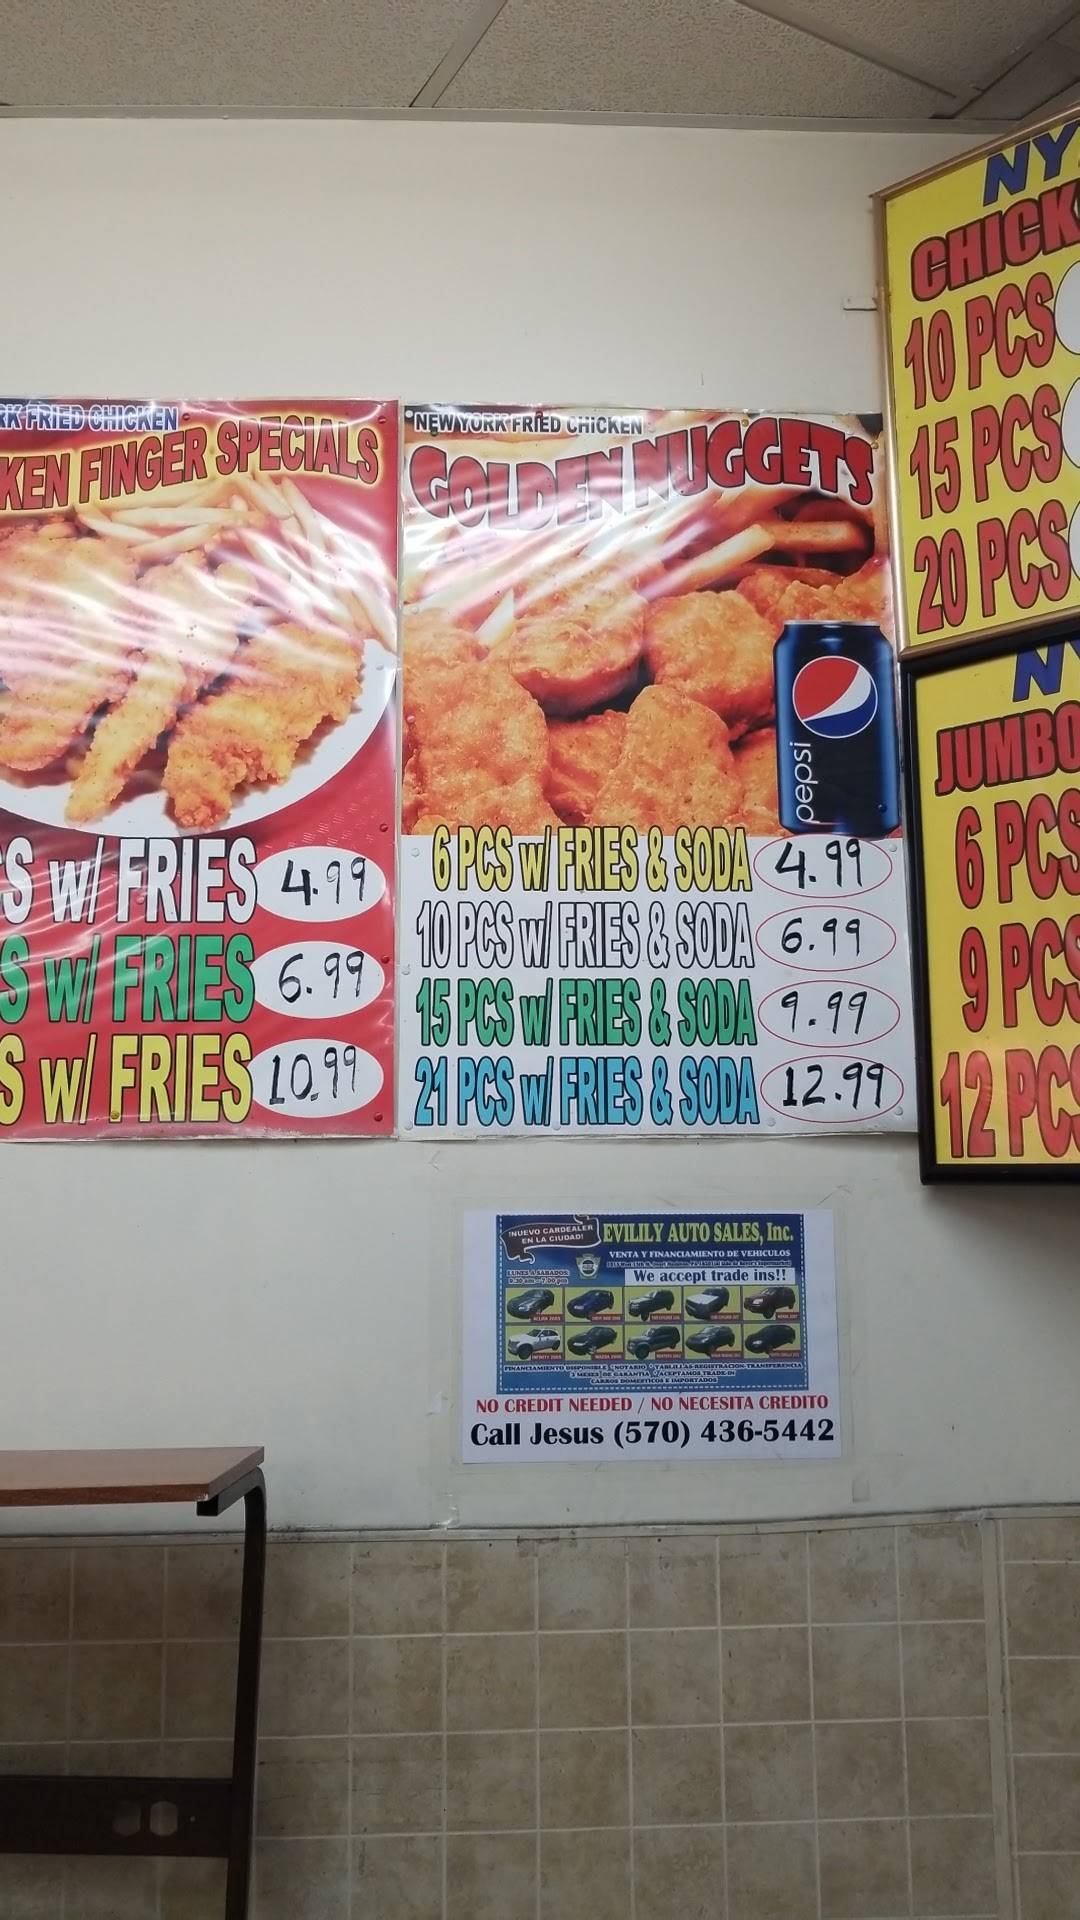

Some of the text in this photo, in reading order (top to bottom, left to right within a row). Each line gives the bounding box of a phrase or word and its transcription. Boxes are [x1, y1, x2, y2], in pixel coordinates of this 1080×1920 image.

[905, 271, 1055, 409] 10 PCS
[26, 404, 84, 431] FRIED
[88, 405, 178, 432] CHICKEN
[512, 415, 561, 433] FRIED
[566, 416, 643, 434] CHICKEN
[909, 383, 1063, 519] 15 PCS
[79, 427, 207, 503] FINGER
[216, 415, 379, 485] SPECIALS
[410, 417, 873, 529] GOLDEN NUGGETS
[913, 499, 1070, 635] 20 PCS
[1013, 639, 1080, 702] N
[789, 742, 820, 824] pepsi
[935, 700, 1080, 796] JUMBO
[49, 837, 103, 924] w/
[117, 837, 258, 924] FRIES
[281, 857, 366, 906] 4.99
[432, 825, 863, 892] 6 PCS w/ FRIES & SODA 4.99
[955, 805, 985, 909] 6
[415, 901, 861, 969] 10 PCS w/ FRIES & SODA 6.99
[43, 933, 101, 1023] w/
[113, 933, 256, 1023] FRIES
[278, 951, 365, 1003] 6.99
[415, 977, 868, 1047] 15 PCS w/ FRIES & SODA 9.99
[961, 927, 989, 1032] 9
[39, 1032, 97, 1125] w/
[109, 1033, 253, 1123] FRIES
[268, 1045, 357, 1105] 10.99
[414, 1056, 885, 1126] 21 PCS w/ FRIES & SODA 12.99
[940, 1050, 995, 1158] 12
[543, 1225, 593, 1235] CARDEALER
[609, 1250, 638, 1258] VENTA
[641, 1250, 648, 1258] Y
[649, 1250, 725, 1258] FINANCIAMIENTO
[740, 1249, 791, 1257] VEHICULOS
[667, 1223, 709, 1242] AUTO
[713, 1222, 764, 1246] SALES,
[767, 1222, 794, 1242] Inc.
[634, 1269, 787, 1284] We accept trade ins!!
[470, 1419, 834, 1448] Call Jesus (570) 436-5442
[476, 1399, 498, 1412] NO
[505, 1398, 563, 1412] CREDIT
[569, 1398, 632, 1412] NEEDED
[652, 1396, 673, 1410] NO
[679, 1396, 754, 1410] NECESITA
[759, 1395, 828, 1409] CREDITO
